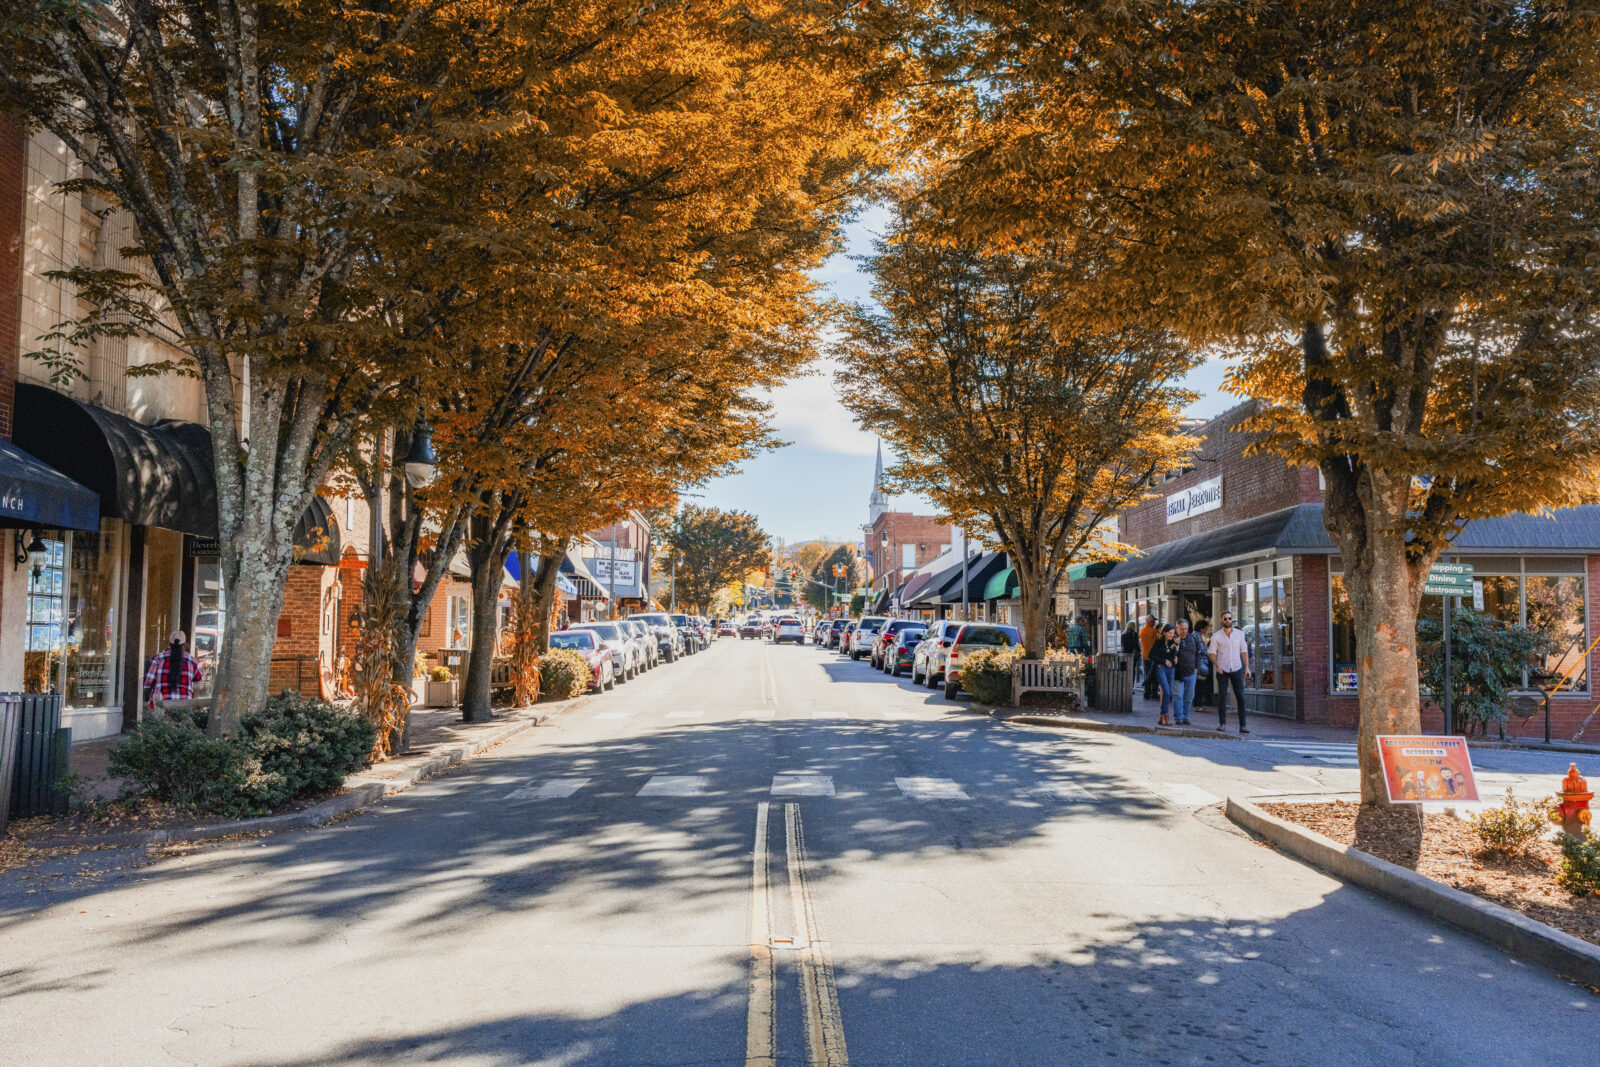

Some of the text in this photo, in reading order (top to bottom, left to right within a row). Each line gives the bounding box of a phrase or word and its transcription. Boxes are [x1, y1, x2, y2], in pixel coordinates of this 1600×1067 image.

[1191, 485, 1220, 508] EXECUTIVE
[1430, 564, 1463, 573] hopping
[1429, 574, 1456, 584] Dining
[1424, 585, 1464, 594] Restrooms
